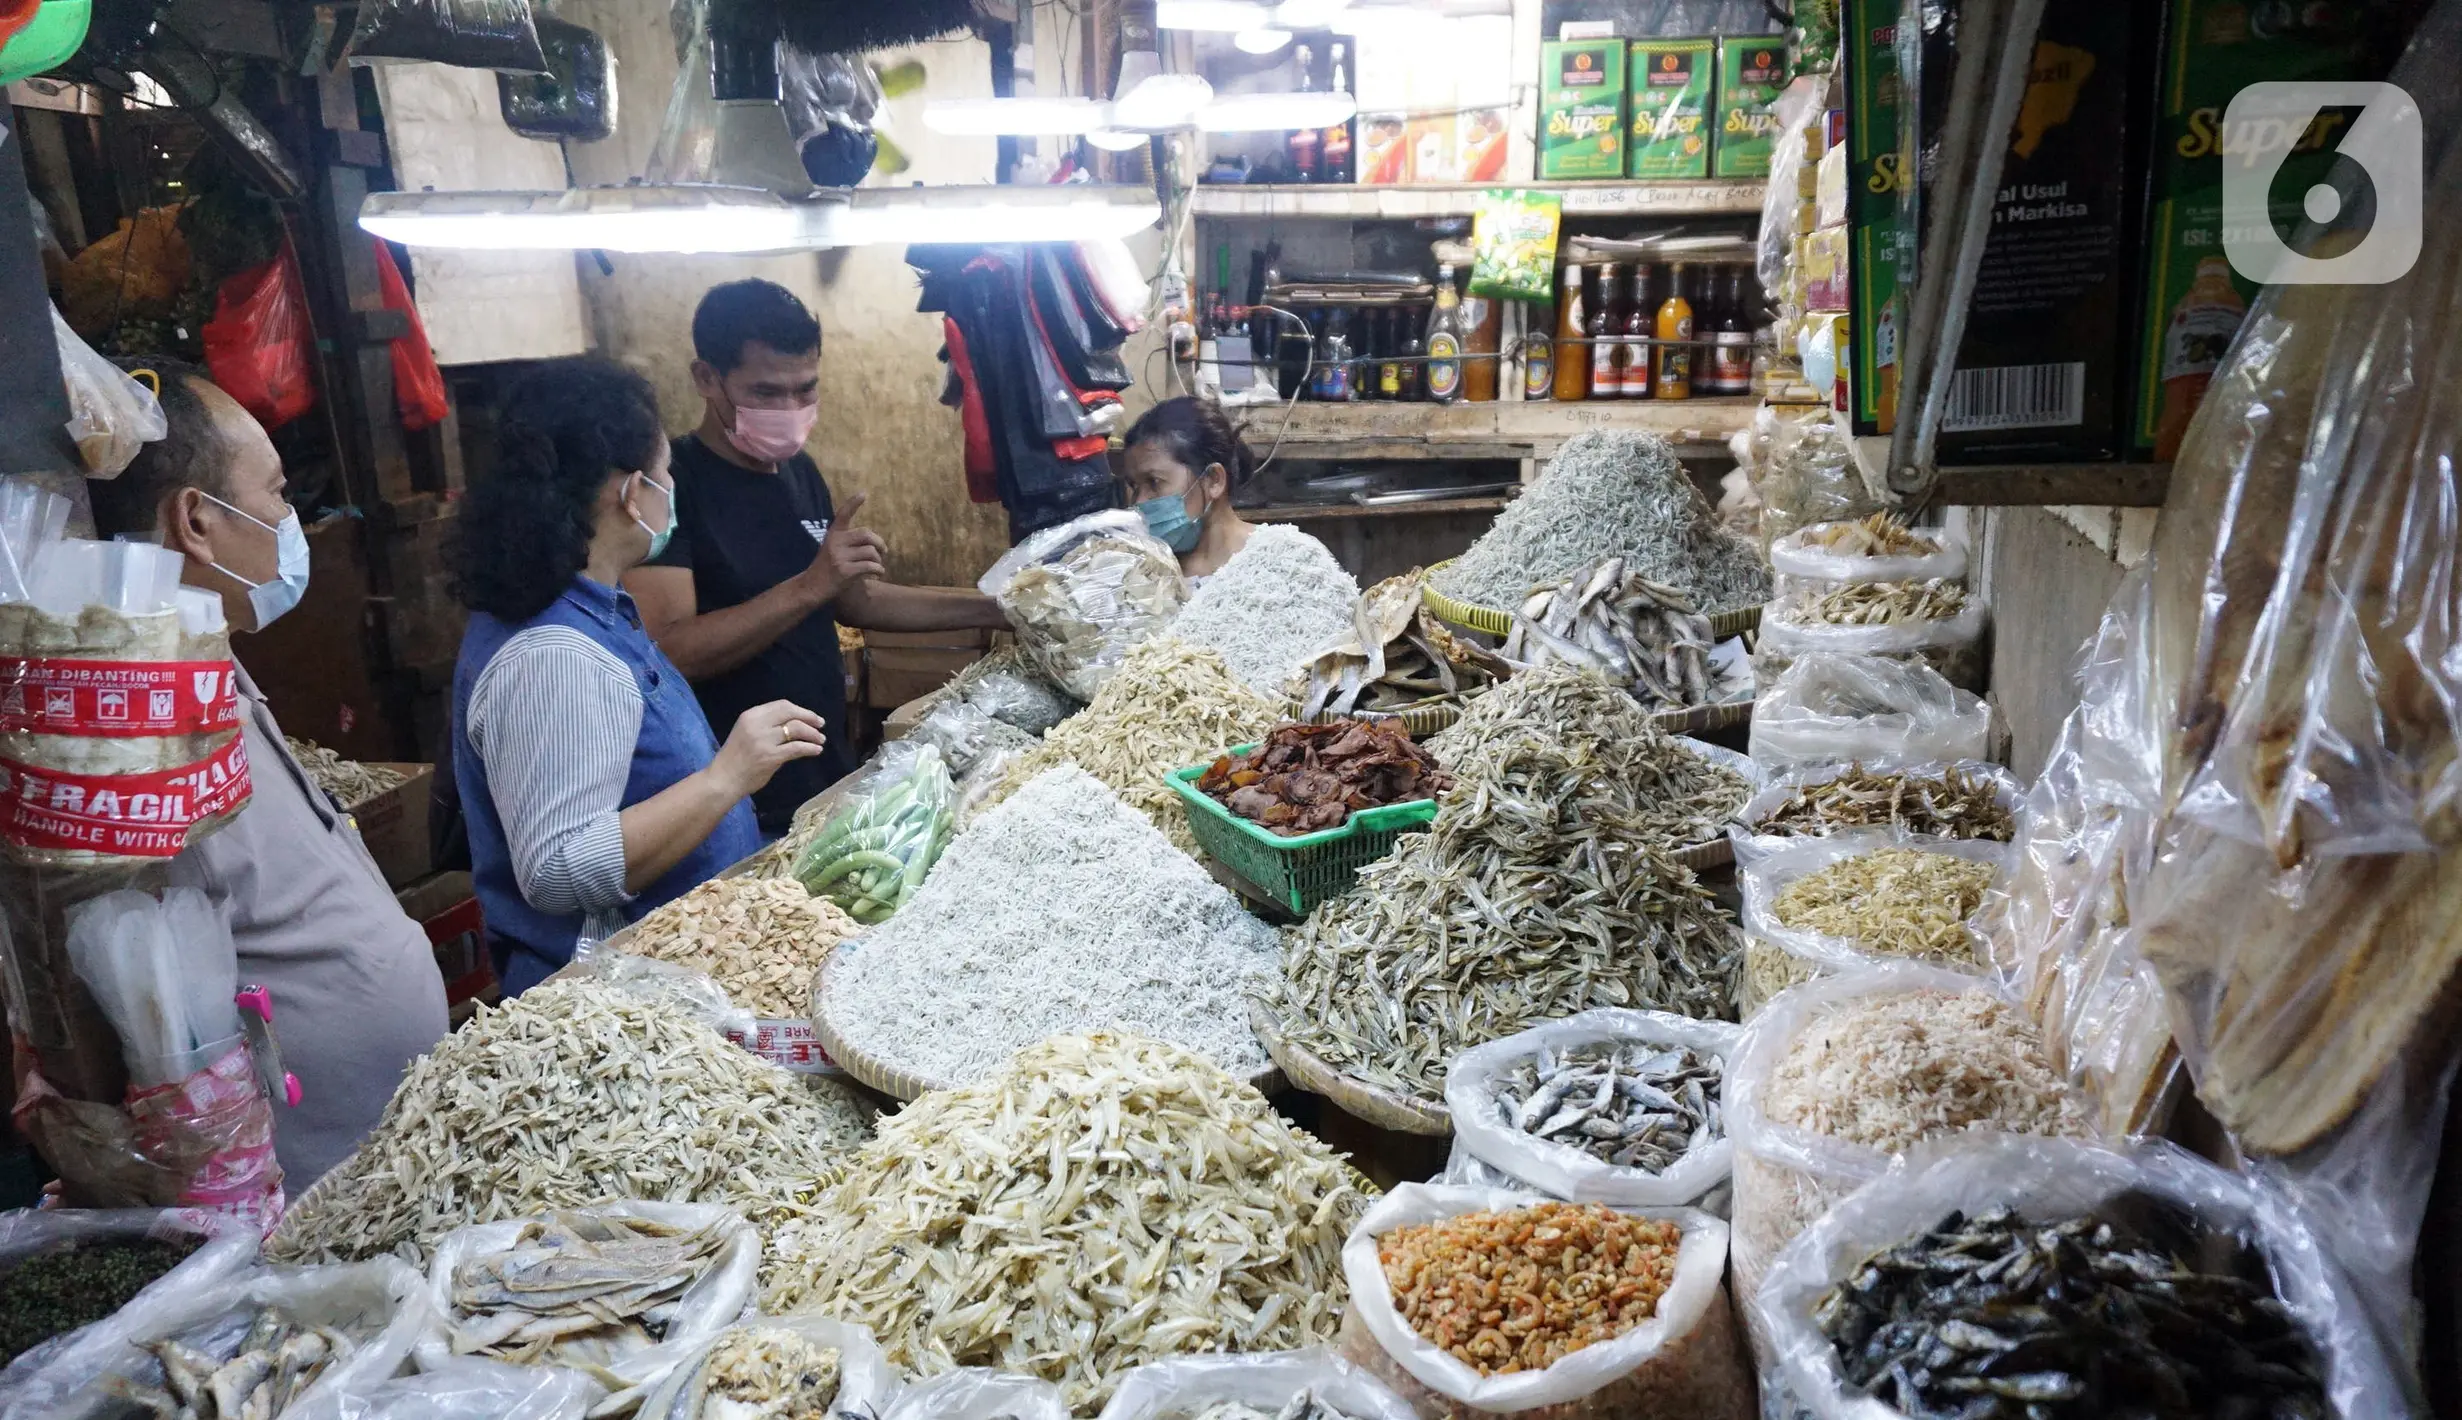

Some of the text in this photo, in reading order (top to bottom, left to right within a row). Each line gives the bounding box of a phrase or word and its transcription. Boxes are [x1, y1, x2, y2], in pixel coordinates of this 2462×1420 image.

[1549, 109, 1618, 140] Super
[1633, 109, 1702, 141] Super
[2176, 107, 2345, 168] Super
[2022, 180, 2068, 201] Usul
[2007, 201, 2088, 223] Markisa
[20, 774, 192, 823] FRAGIL
[12, 807, 105, 843] HANDLE
[114, 829, 167, 848] WITH
